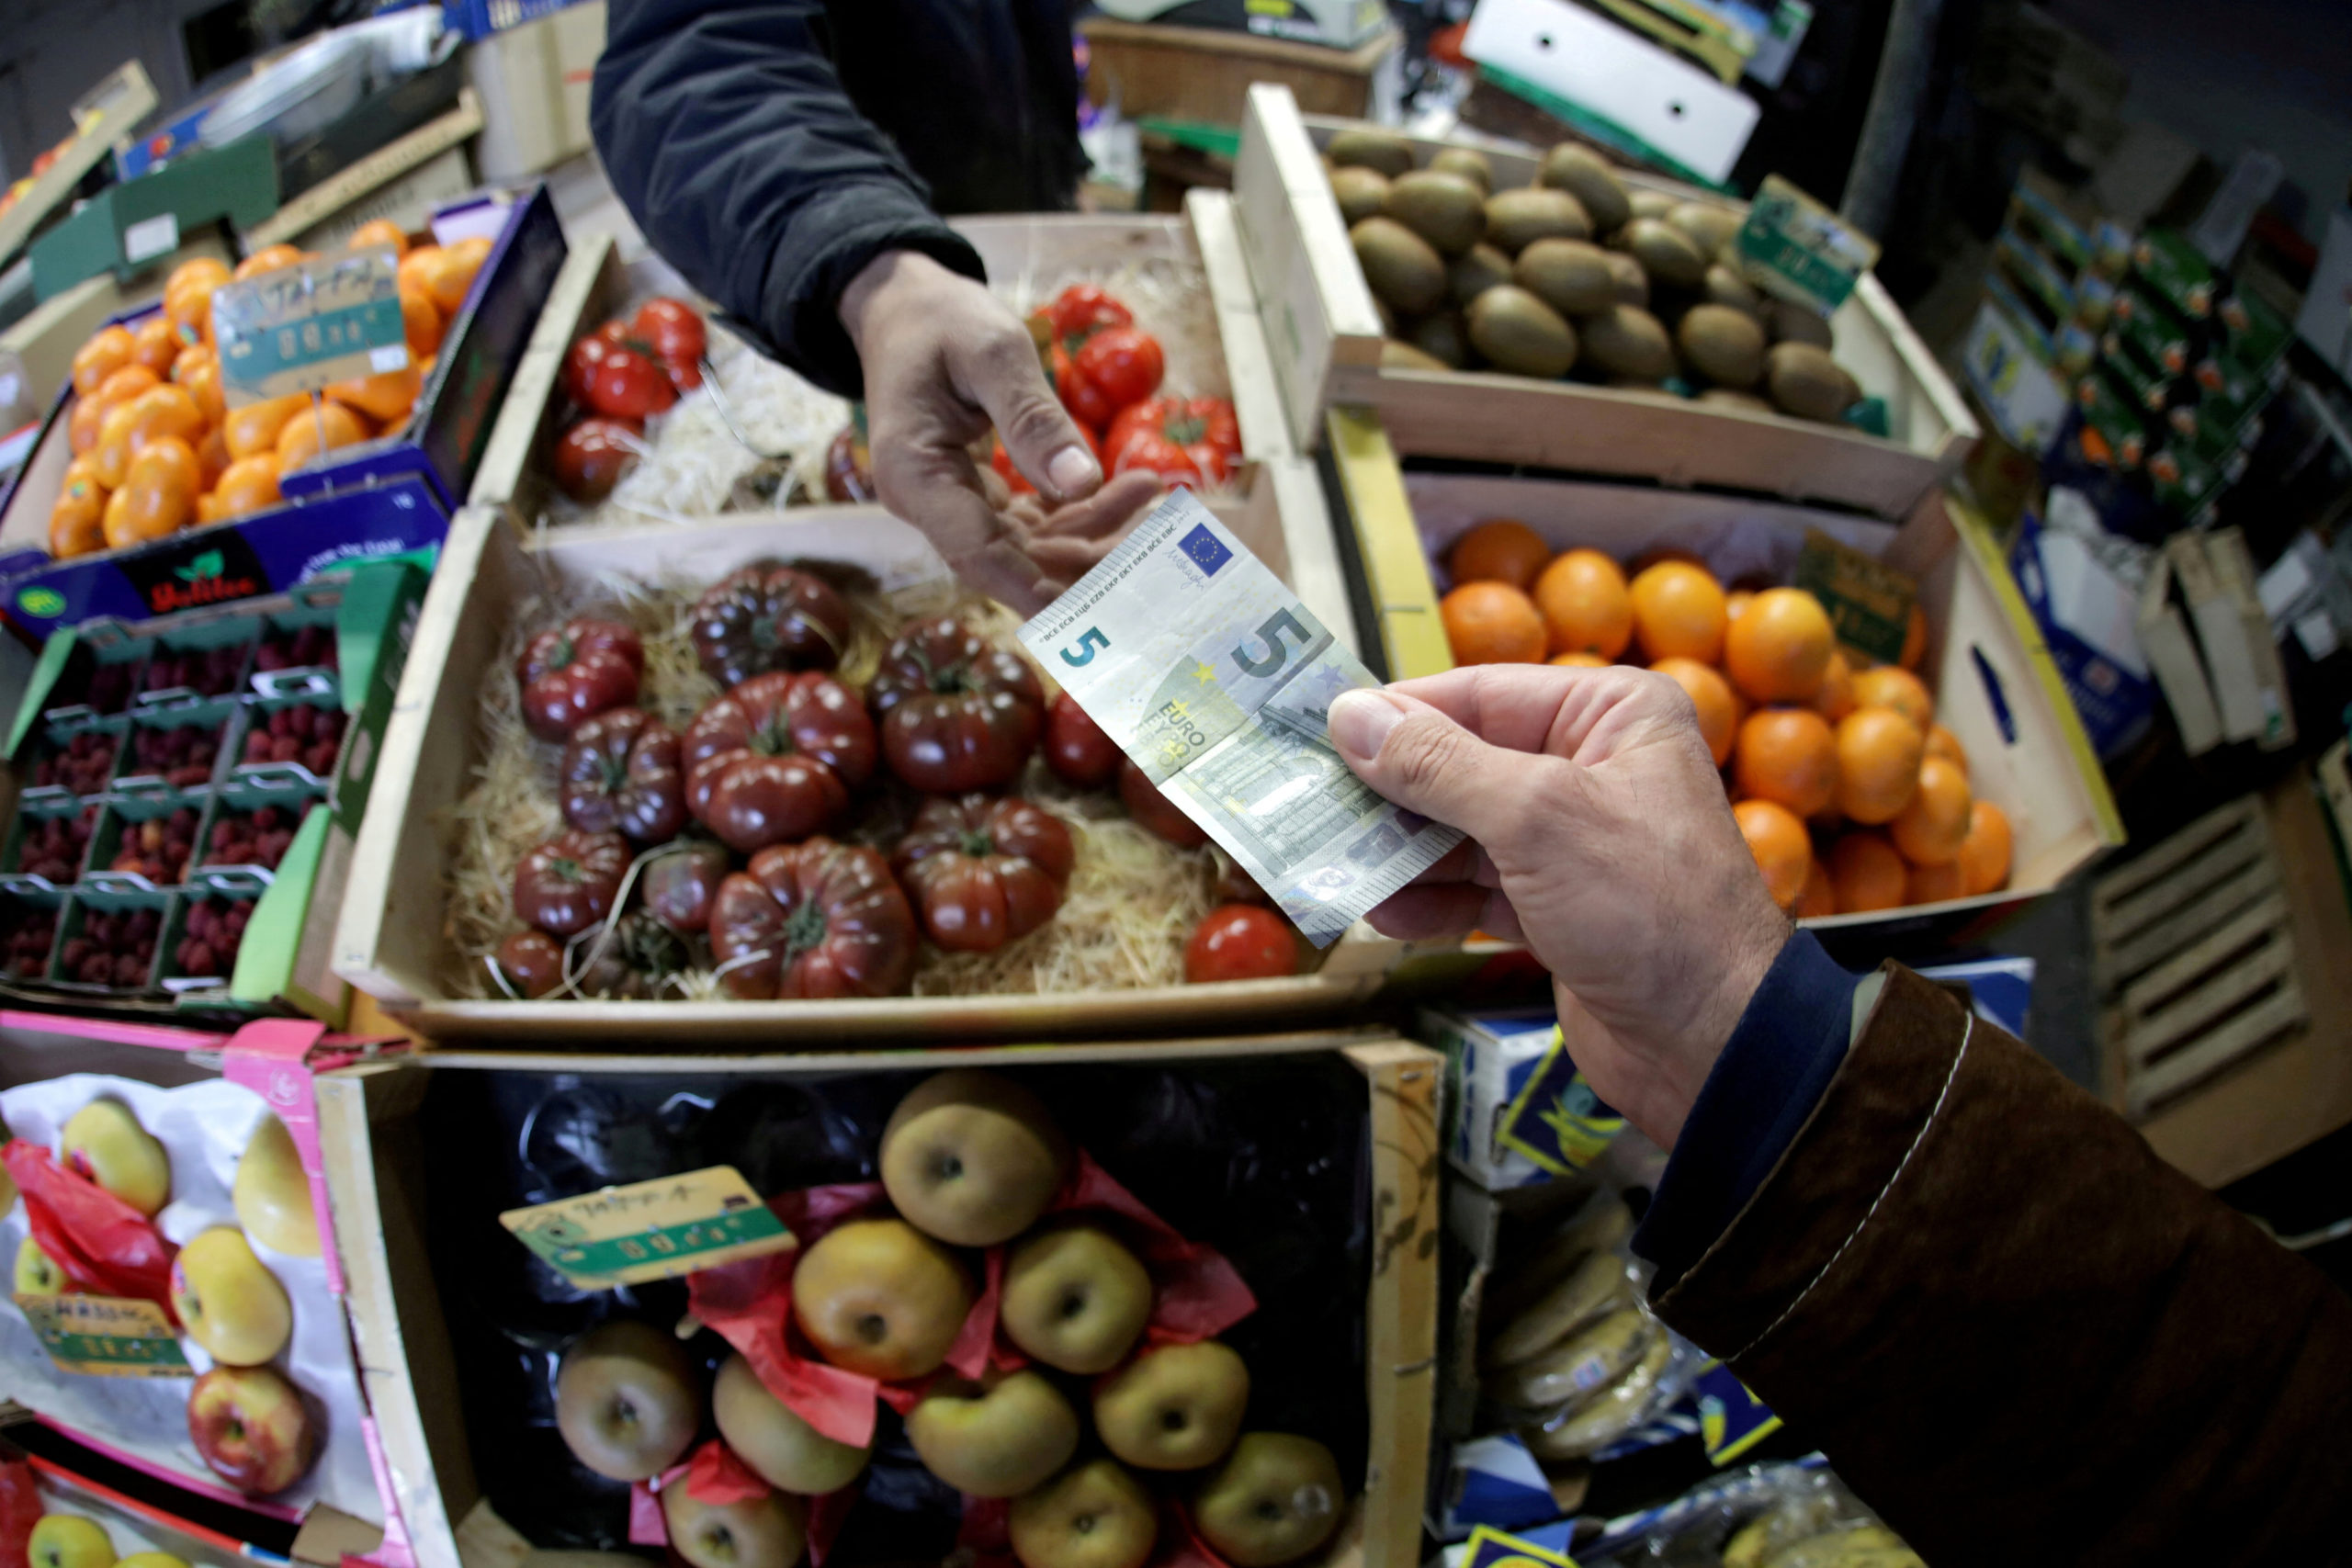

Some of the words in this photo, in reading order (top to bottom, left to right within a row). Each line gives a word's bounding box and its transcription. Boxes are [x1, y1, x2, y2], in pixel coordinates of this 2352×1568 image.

[1059, 626, 1112, 668] 5
[1230, 606, 1312, 679] 5
[1159, 701, 1205, 747] EURO
